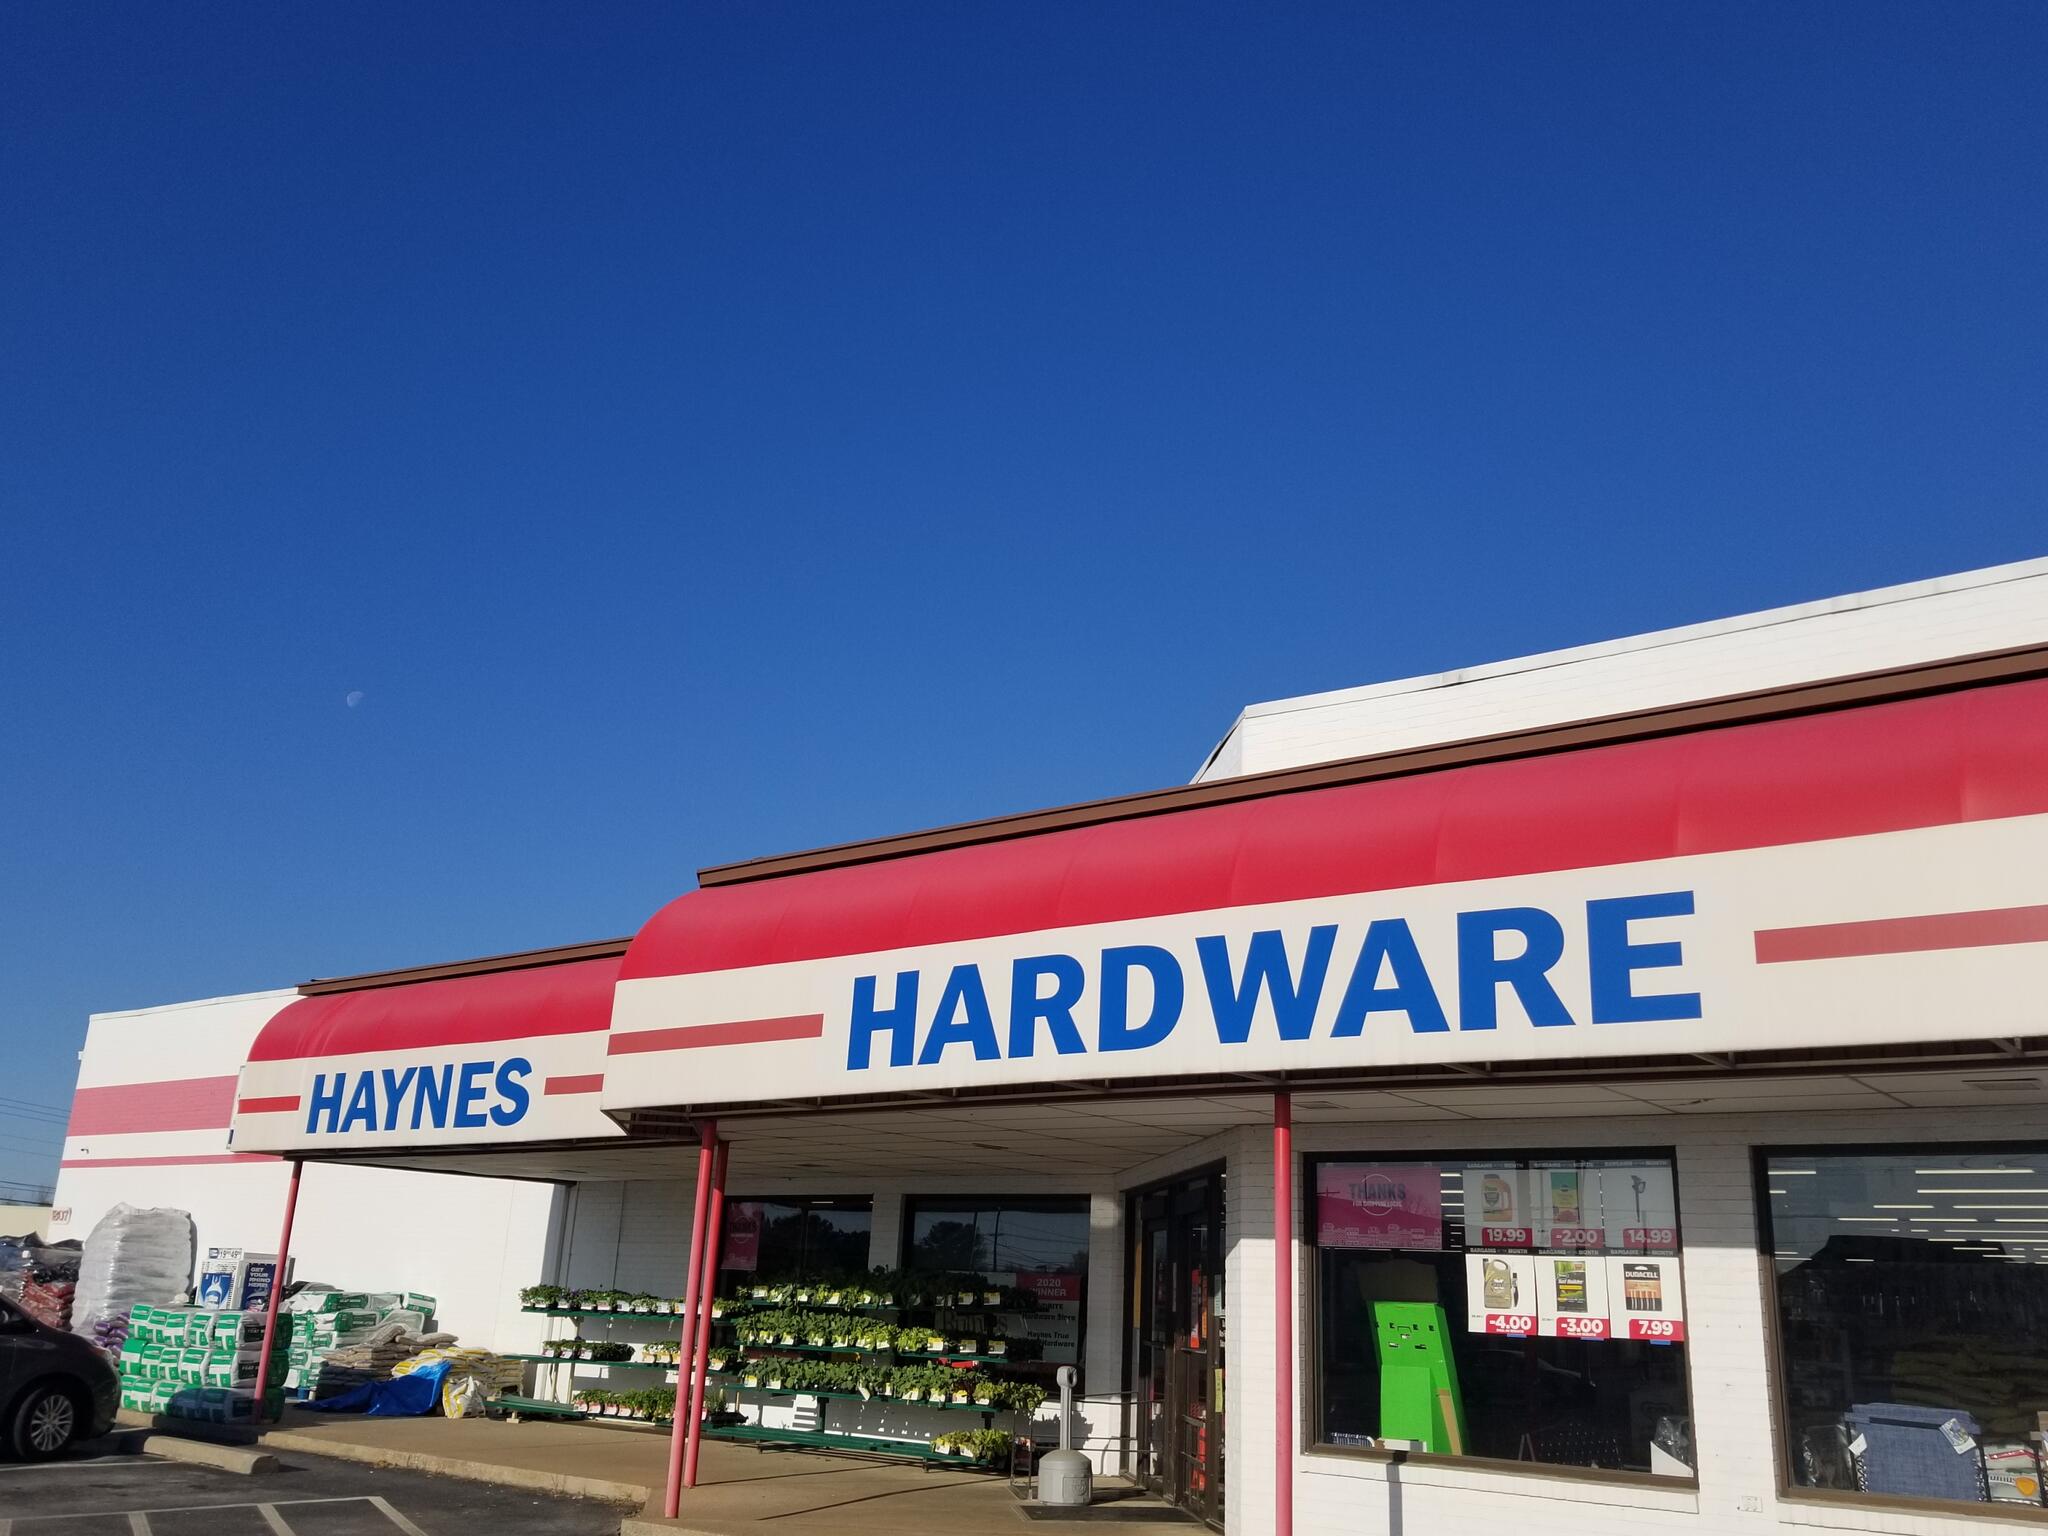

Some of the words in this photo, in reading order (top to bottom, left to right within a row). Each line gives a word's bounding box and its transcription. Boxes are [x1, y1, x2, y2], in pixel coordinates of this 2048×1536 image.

[848, 892, 1700, 1070] HARDWARE
[308, 1058, 531, 1132] HAYNES
[1349, 1183, 1406, 1200] THANKS
[1487, 1229, 1526, 1242] 19.99
[1556, 1230, 1598, 1243] -2.00
[1628, 1230, 1672, 1243] 14.99
[1037, 1278, 1061, 1287] 2020
[1490, 1315, 1532, 1330] -4.00
[1561, 1318, 1603, 1333] -3.00
[1638, 1320, 1673, 1336] 7.99
[1053, 1331, 1070, 1339] True
